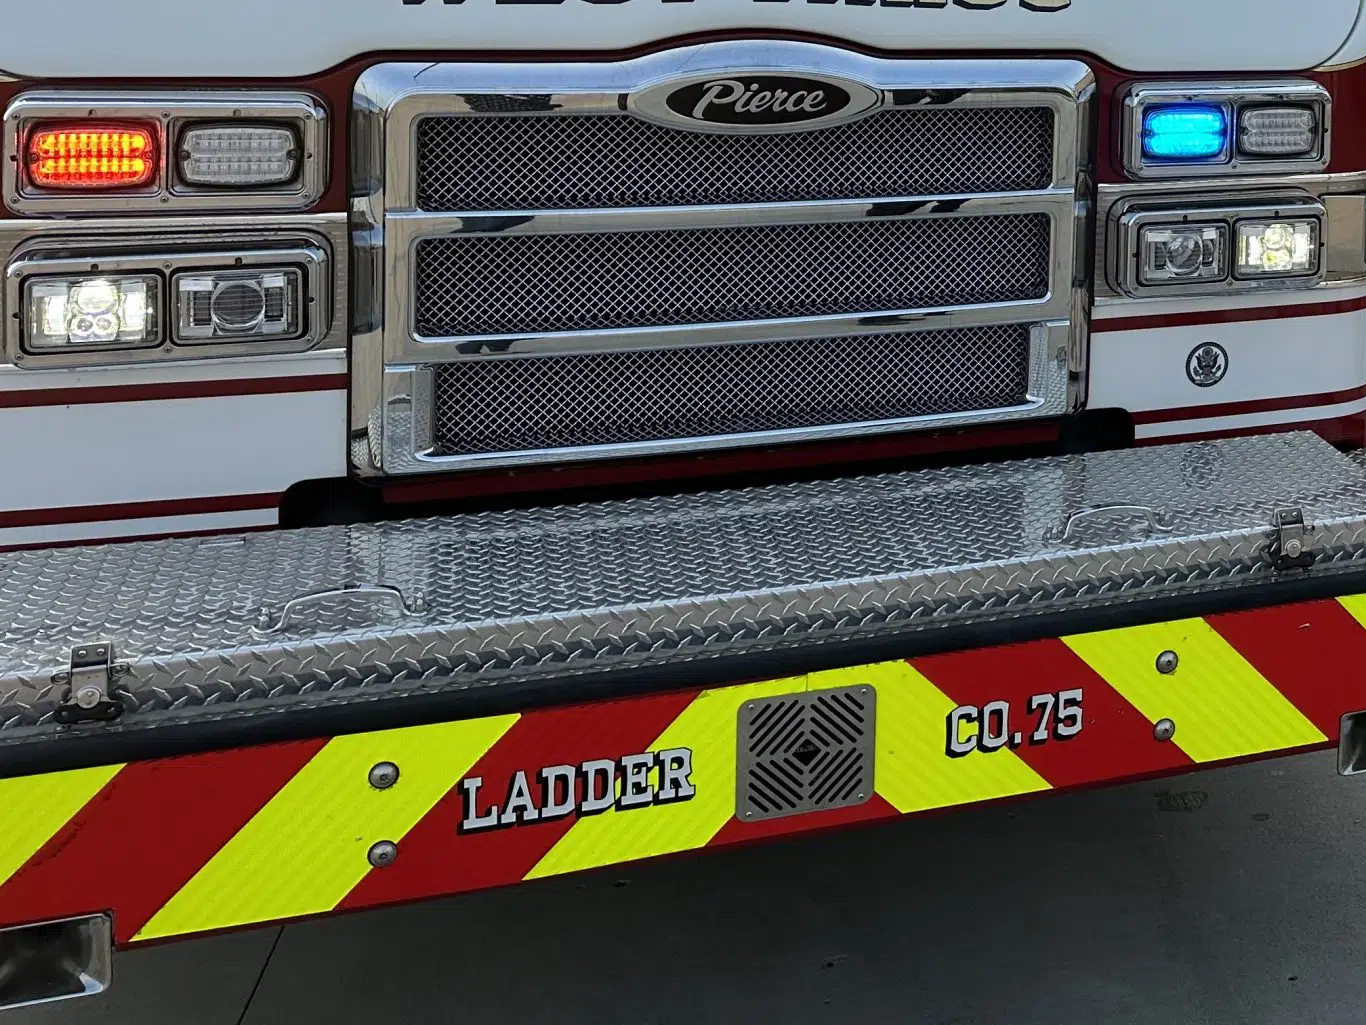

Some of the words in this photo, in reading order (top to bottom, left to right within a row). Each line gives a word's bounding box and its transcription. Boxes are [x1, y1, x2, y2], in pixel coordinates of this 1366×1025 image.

[692, 79, 828, 119] Pierce
[457, 747, 696, 835] LADDER
[945, 688, 1085, 759] CO.75
